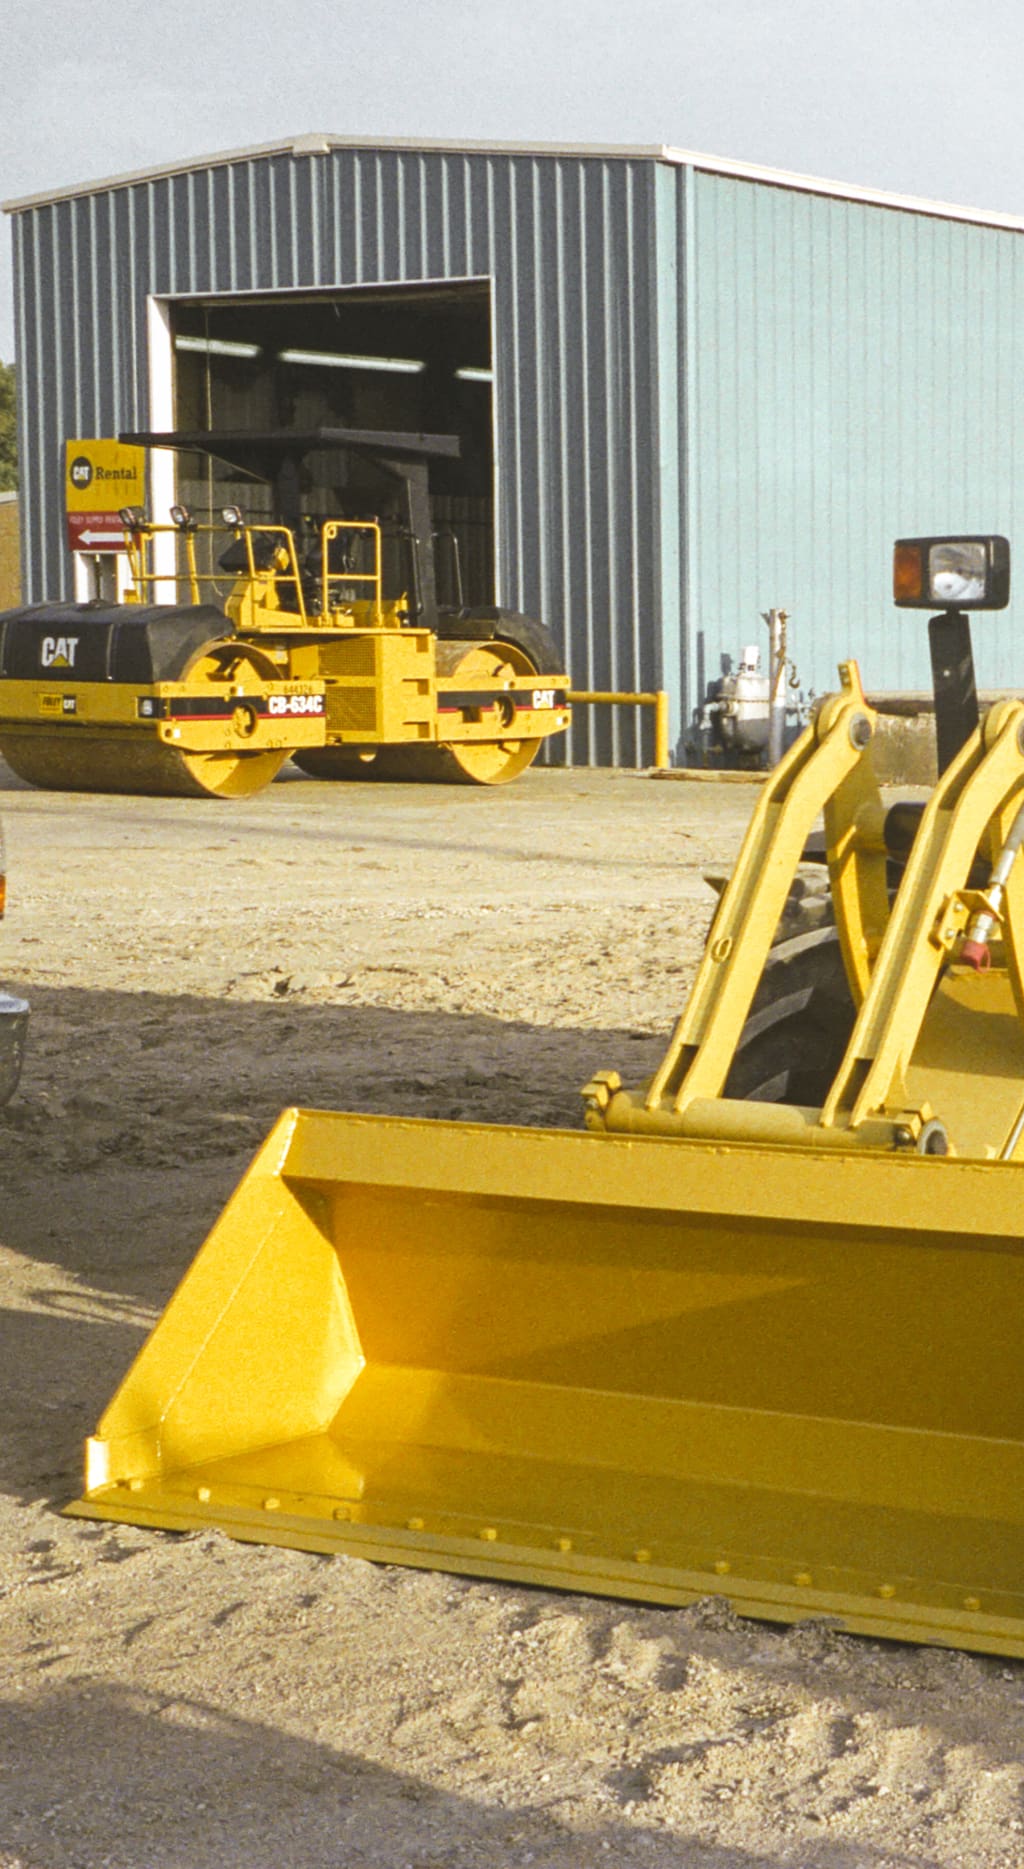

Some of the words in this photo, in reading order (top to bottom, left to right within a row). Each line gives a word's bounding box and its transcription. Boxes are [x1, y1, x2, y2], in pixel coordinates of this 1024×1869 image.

[73, 466, 90, 481] CAT
[96, 467, 137, 480] Rental
[41, 637, 79, 668] CAT
[269, 695, 323, 714] CB-634C
[532, 690, 555, 709] CAT
